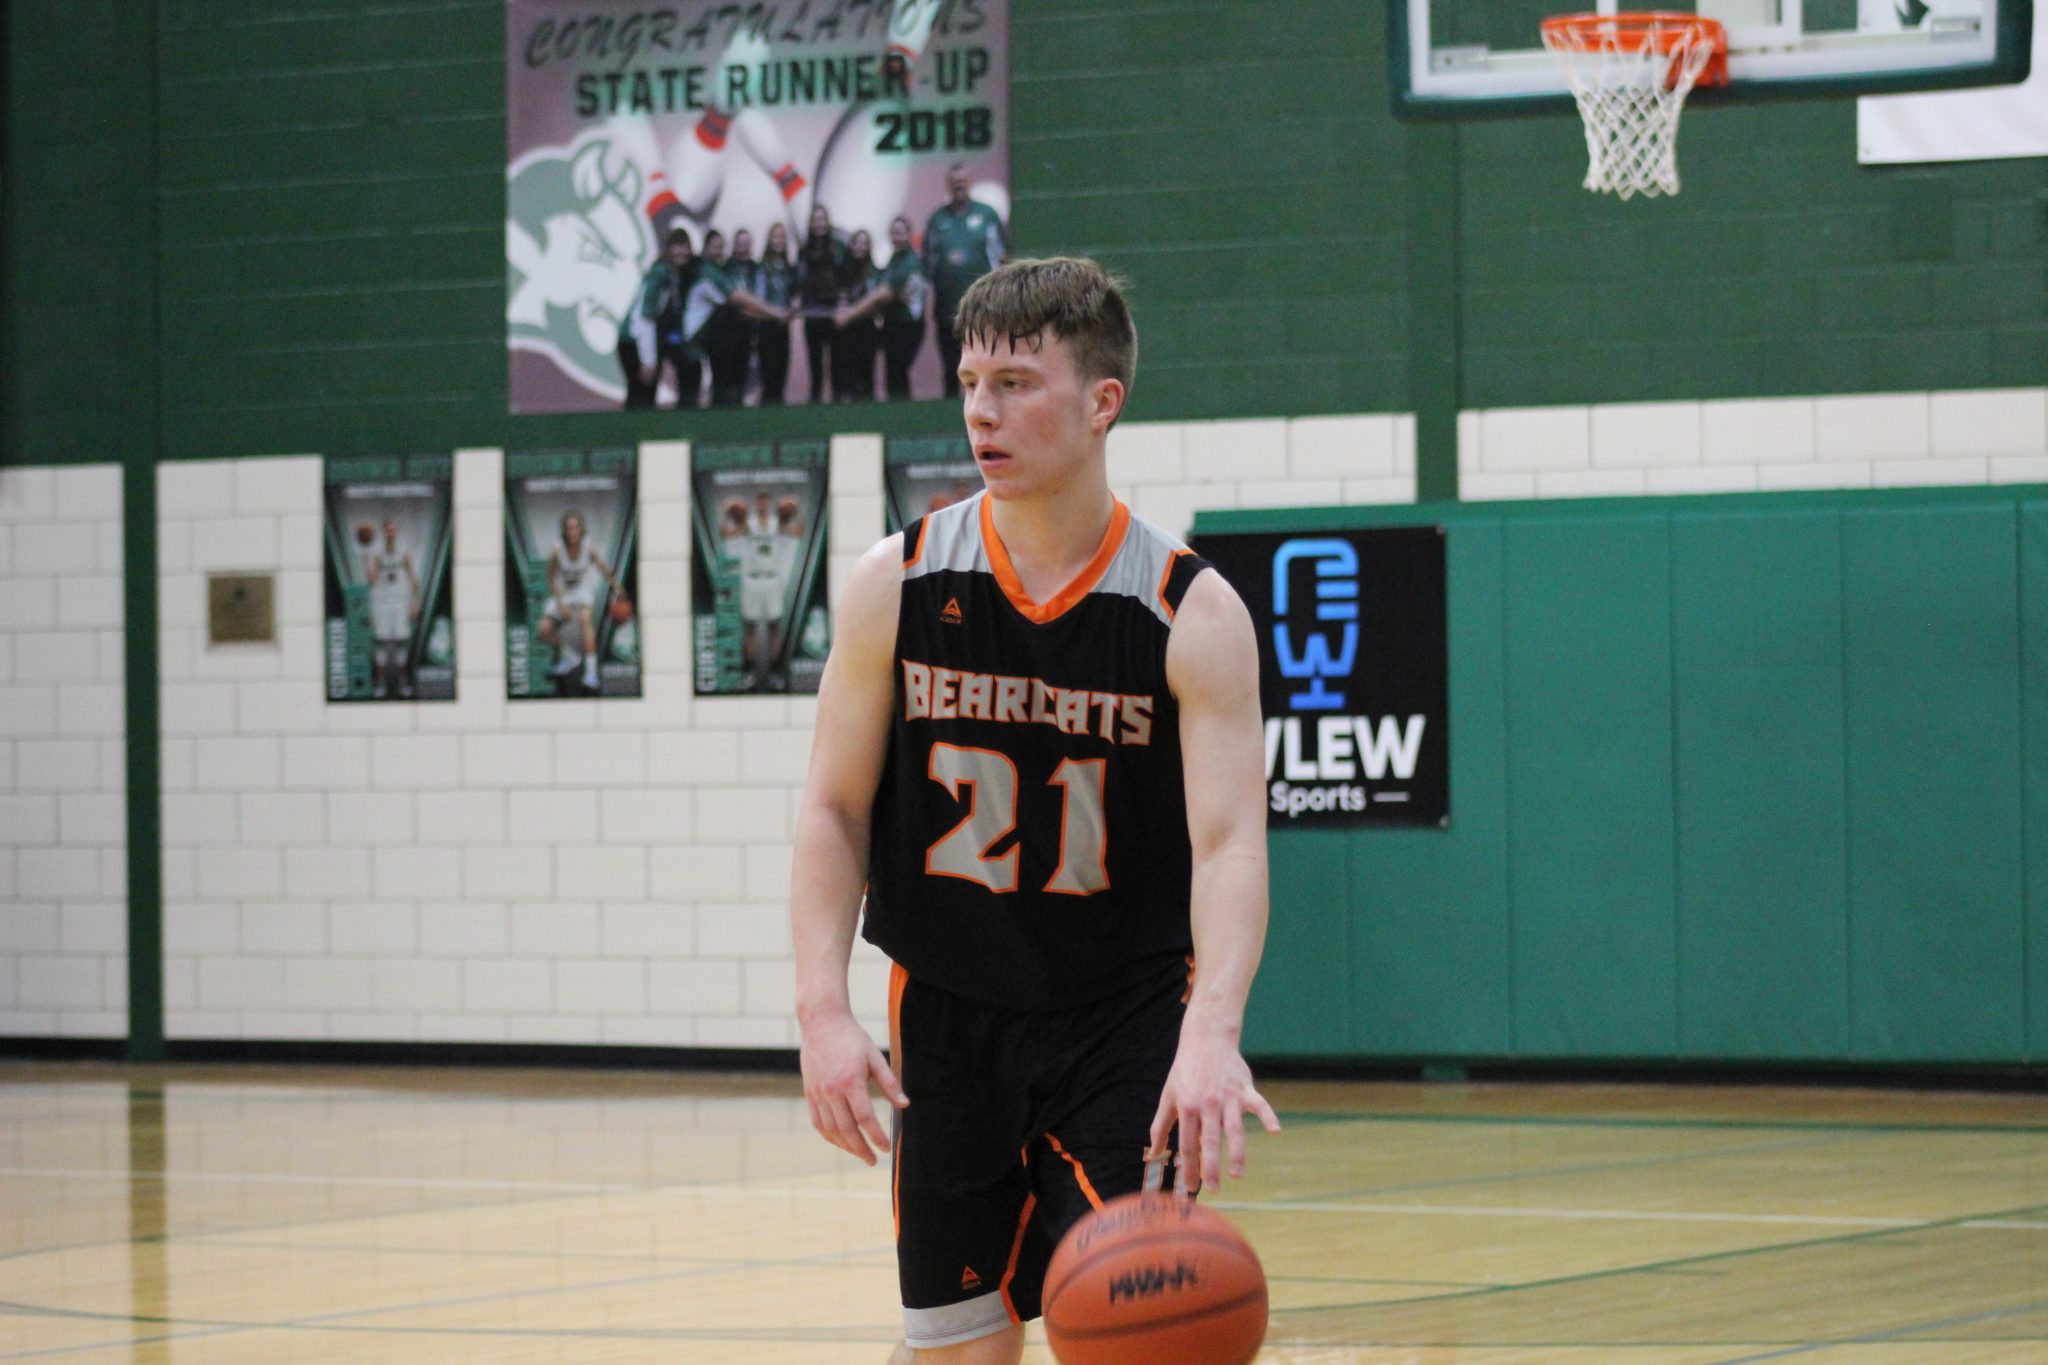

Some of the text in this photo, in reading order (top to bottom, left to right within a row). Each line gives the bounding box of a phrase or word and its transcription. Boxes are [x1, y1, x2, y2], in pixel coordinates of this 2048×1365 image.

[524, 0, 986, 68] CONGRATULATIONS
[576, 65, 707, 117] STATE
[875, 108, 992, 151] 2018
[902, 658, 1154, 747] BEARCATS
[925, 741, 1111, 896] 21
[1270, 781, 1367, 819] Sports
